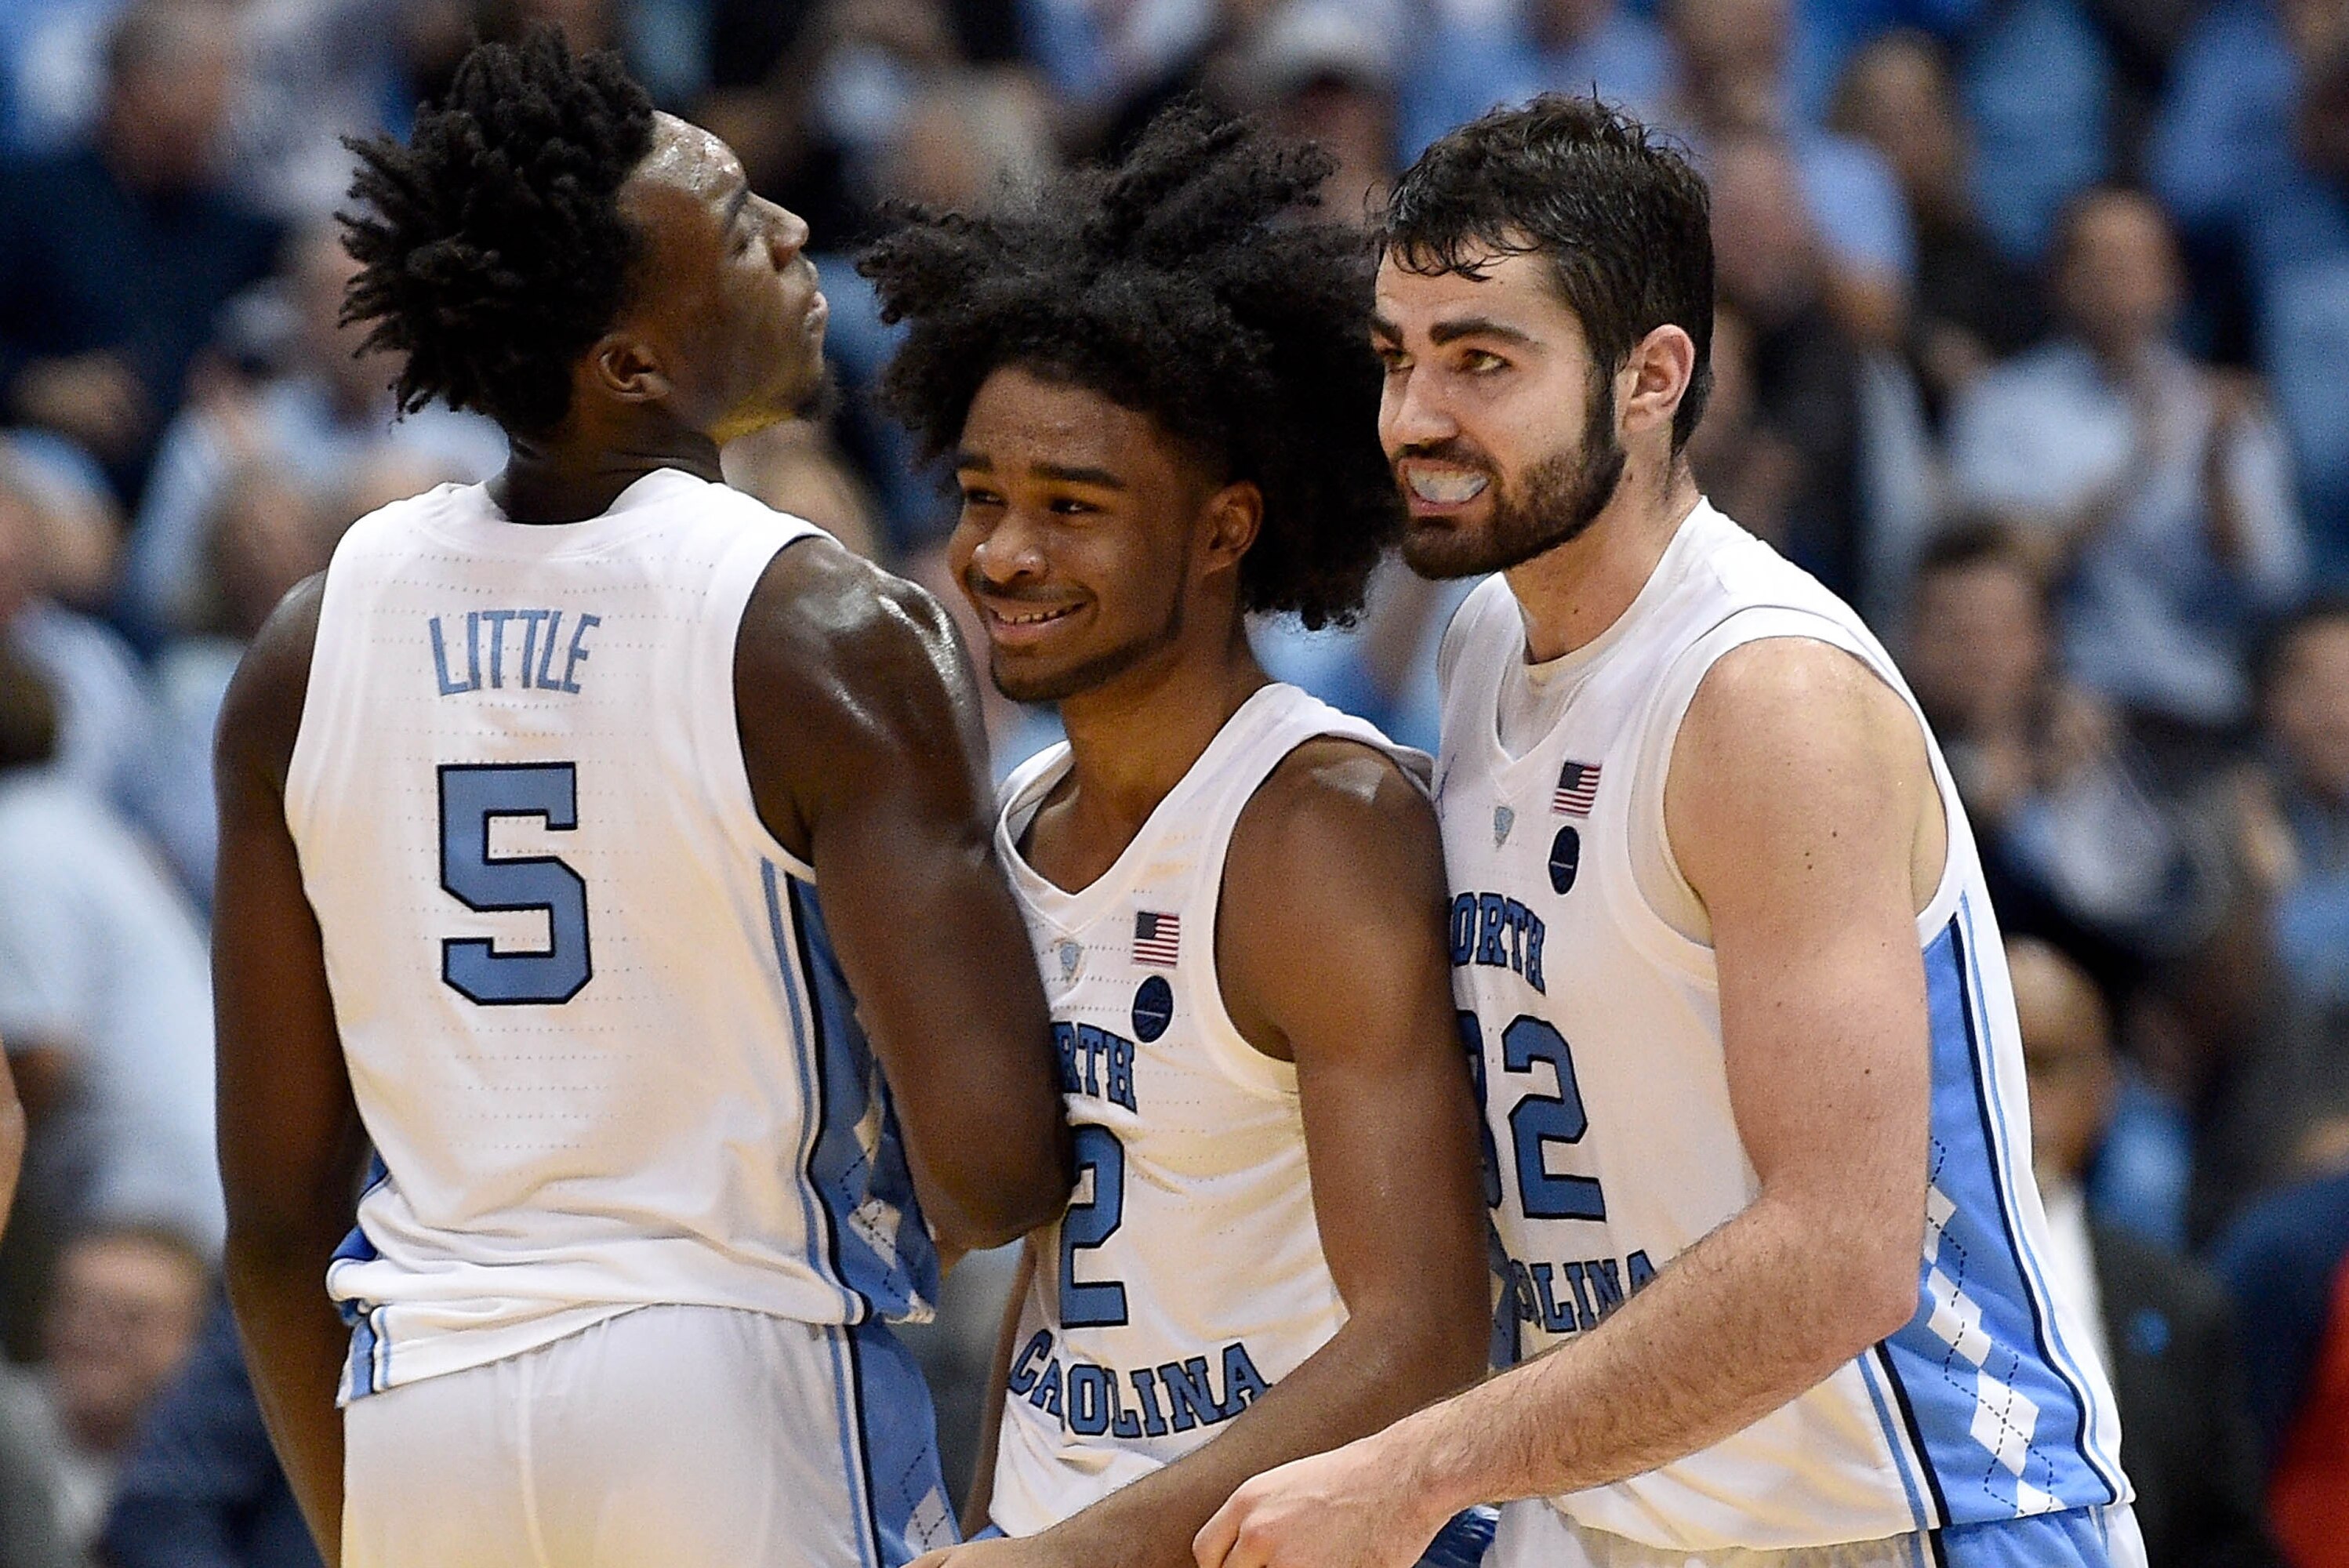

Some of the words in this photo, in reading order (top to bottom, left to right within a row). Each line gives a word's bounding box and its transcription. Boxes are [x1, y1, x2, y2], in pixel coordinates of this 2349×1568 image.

[429, 609, 601, 695] LITTLE
[437, 761, 593, 1006] 5
[1444, 891, 1546, 997] ORTH
[1049, 1021, 1138, 1115] RTH
[1059, 1123, 1127, 1329] 2
[1007, 1328, 1273, 1439] CAOLINA
